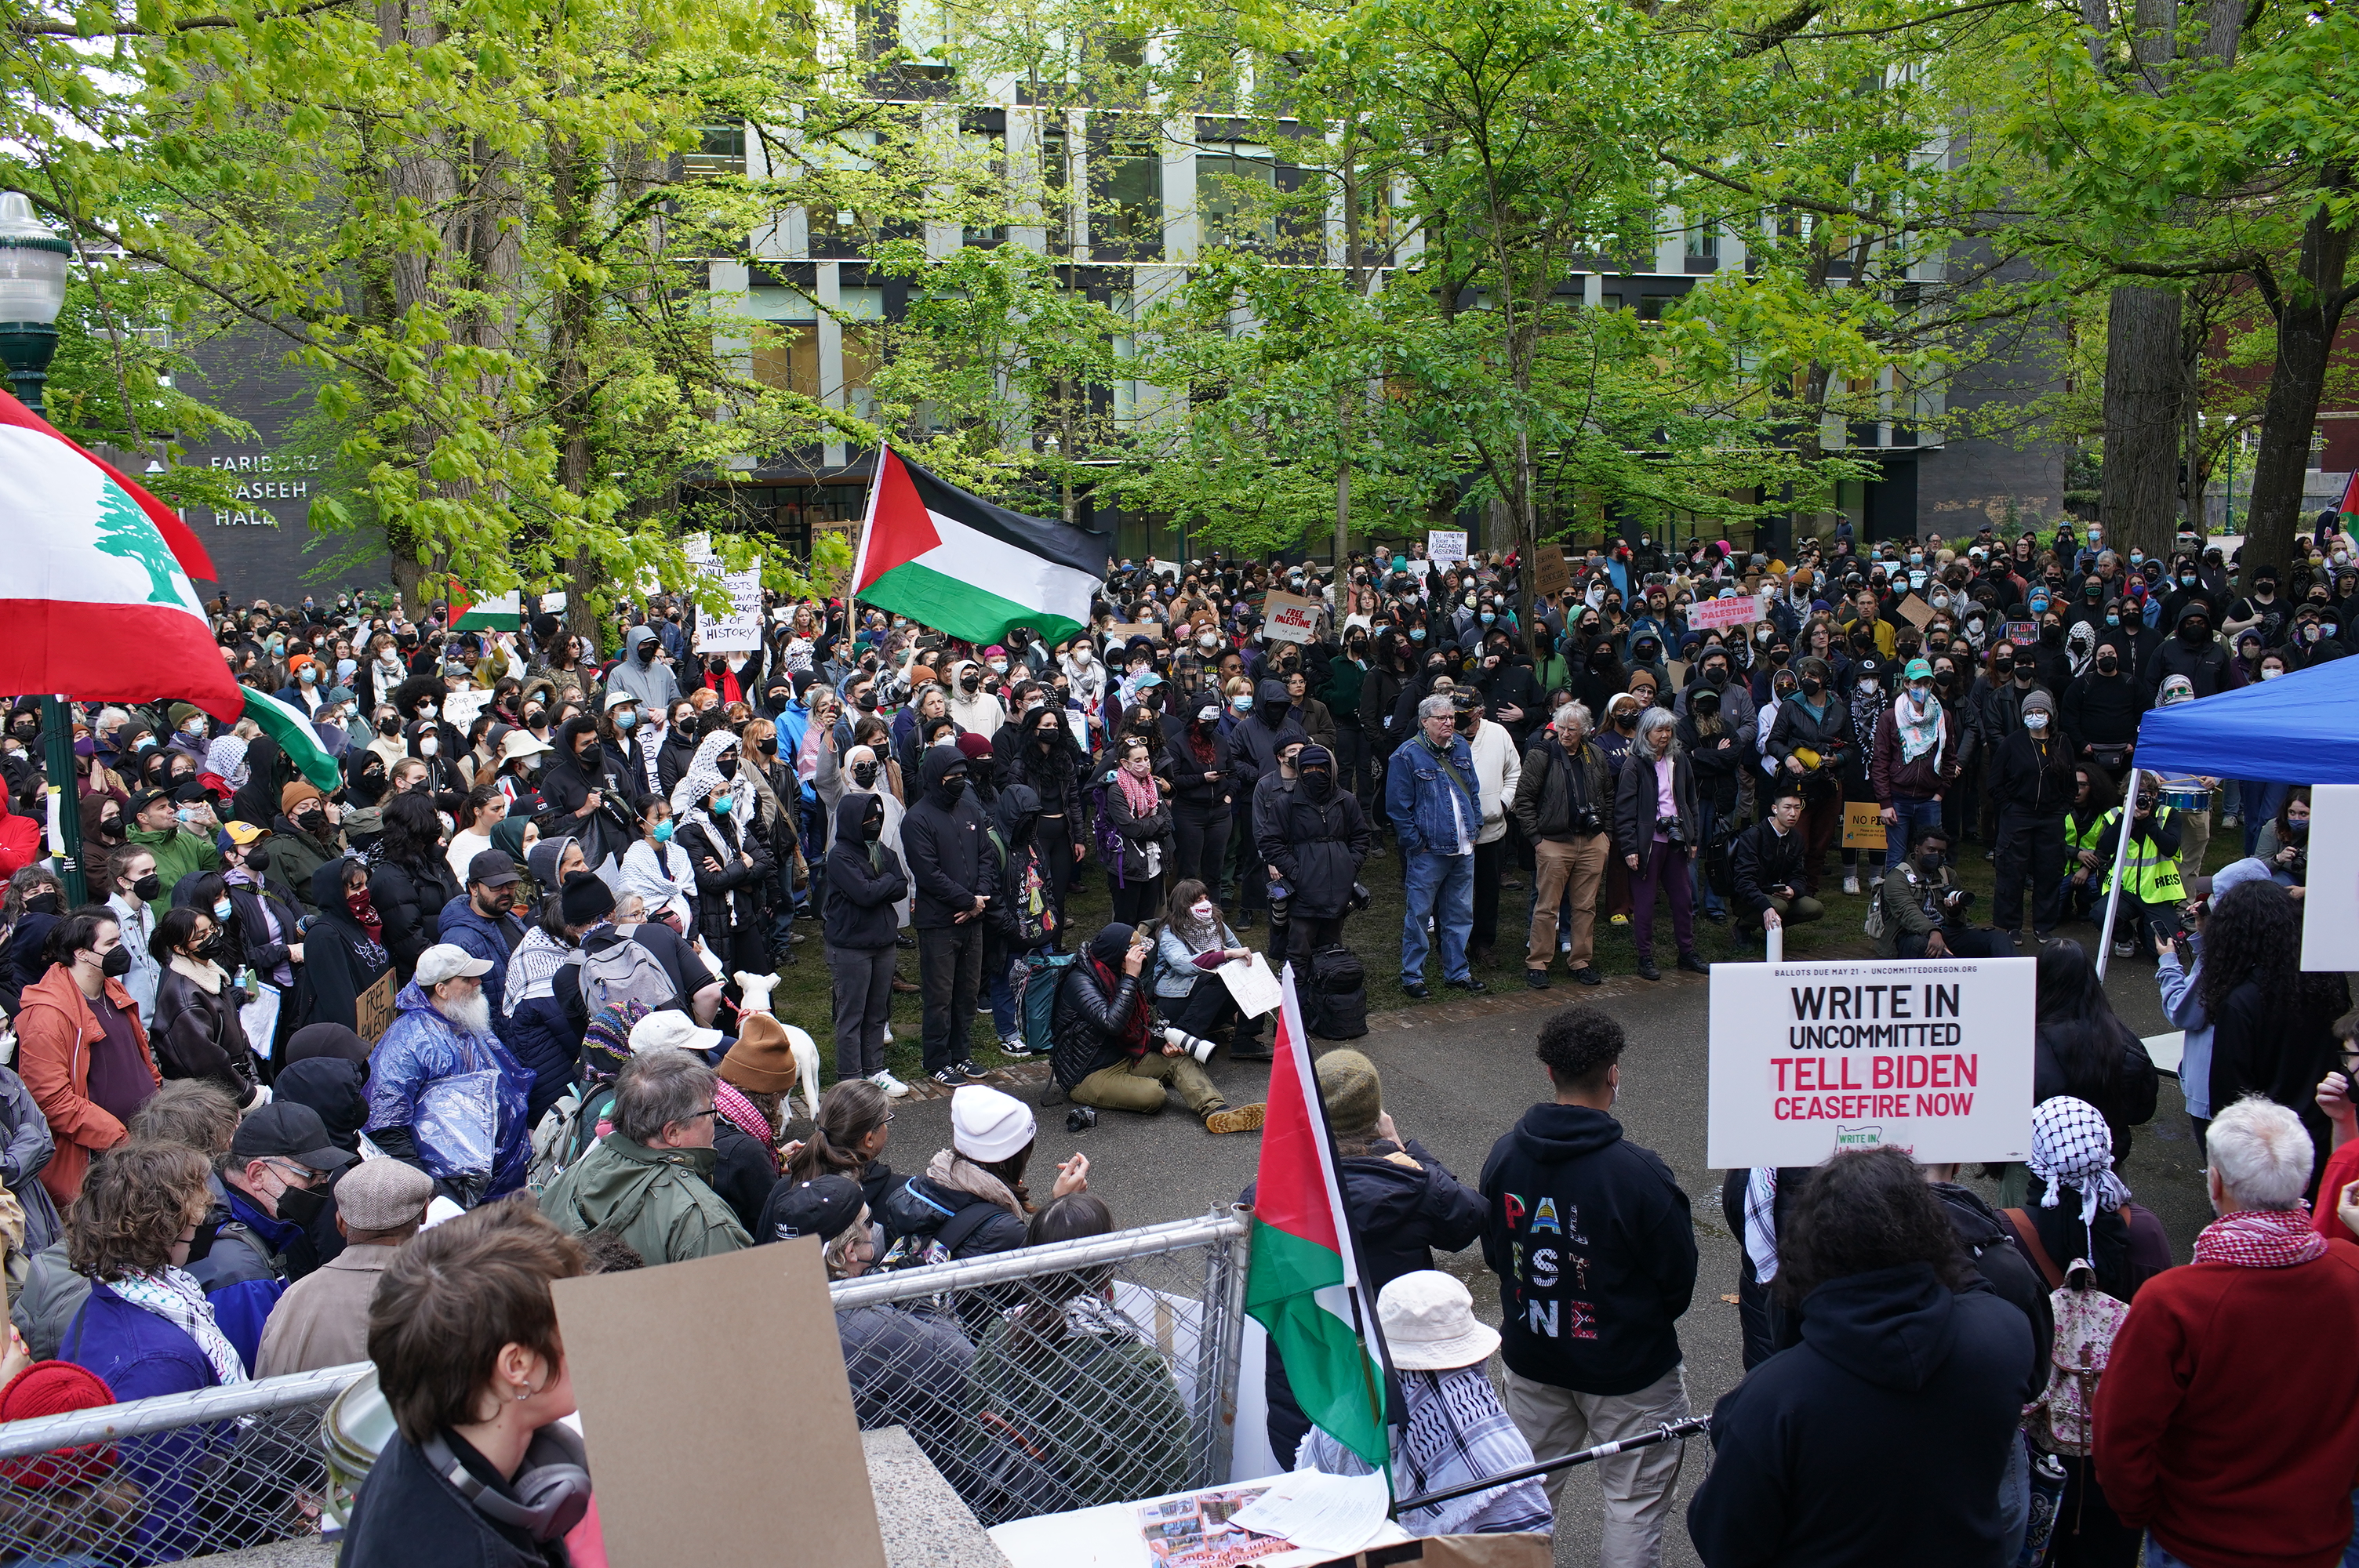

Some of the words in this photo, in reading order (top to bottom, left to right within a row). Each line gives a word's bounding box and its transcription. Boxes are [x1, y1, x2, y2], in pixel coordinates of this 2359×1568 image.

[215, 508, 274, 526] HALL
[1535, 553, 1557, 564] OEING
[734, 604, 761, 614] RIGHT
[1714, 598, 1739, 608] FREE
[1285, 608, 1305, 618] FREE
[1701, 606, 1754, 620] PALESTINE
[700, 617, 724, 627] SIDE
[729, 616, 745, 625] OF
[1274, 614, 1312, 629] PALESTINE
[707, 628, 756, 640] HISTORY
[447, 696, 469, 707] Stop
[471, 694, 488, 702] The
[640, 731, 657, 765] BLOOD
[1852, 815, 1866, 824] NO
[2155, 873, 2181, 888] PRESS
[1871, 966, 1978, 975] UNCOMMITTEDOREGON.ORG
[366, 980, 386, 1021] FREE
[1791, 985, 1912, 1021] WRITE
[1925, 984, 1960, 1018] IN
[1790, 1023, 1961, 1050] UNCOMMITTED
[1771, 1056, 1862, 1091] TELL
[1872, 1054, 1978, 1090] BIDEN
[1775, 1094, 1910, 1120] CEASEFIRE
[1917, 1093, 1974, 1117] NOW
[1839, 1134, 1866, 1143] WRITE
[1868, 1134, 1877, 1143] IN
